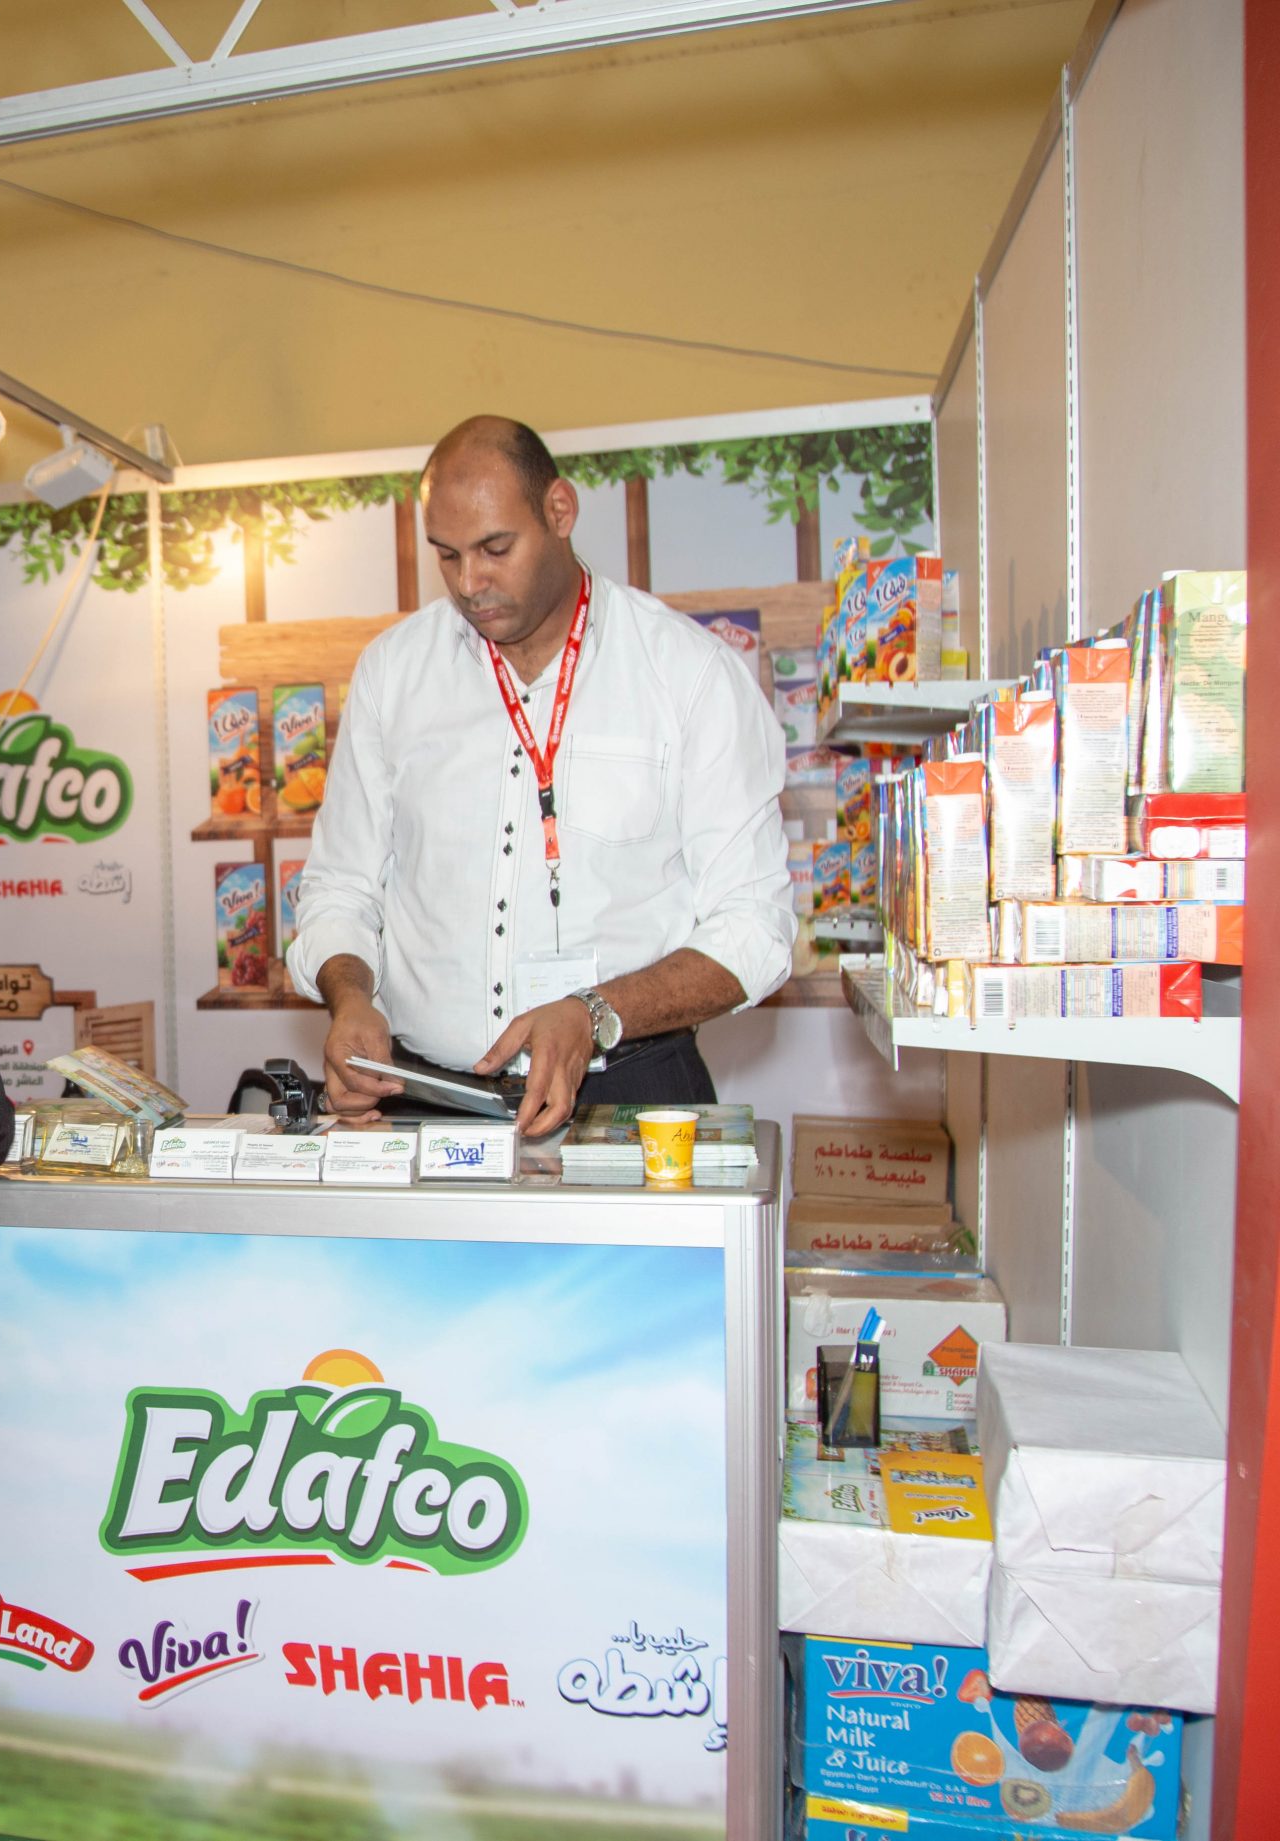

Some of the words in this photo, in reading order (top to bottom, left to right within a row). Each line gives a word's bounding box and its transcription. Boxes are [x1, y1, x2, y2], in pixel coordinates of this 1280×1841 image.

[815, 1142, 872, 1160] طماطم
[879, 1144, 933, 1163] صلصة
[118, 1407, 508, 1549] Edafco
[914, 1507, 970, 1524] Viva!
[118, 1598, 253, 1683] Viva!
[282, 1642, 510, 1711] SHAHIA
[822, 1649, 949, 1698] viva!
[826, 1704, 910, 1731] Natural
[826, 1726, 877, 1748] Milk
[825, 1749, 846, 1768] &
[852, 1751, 910, 1775] Juice
